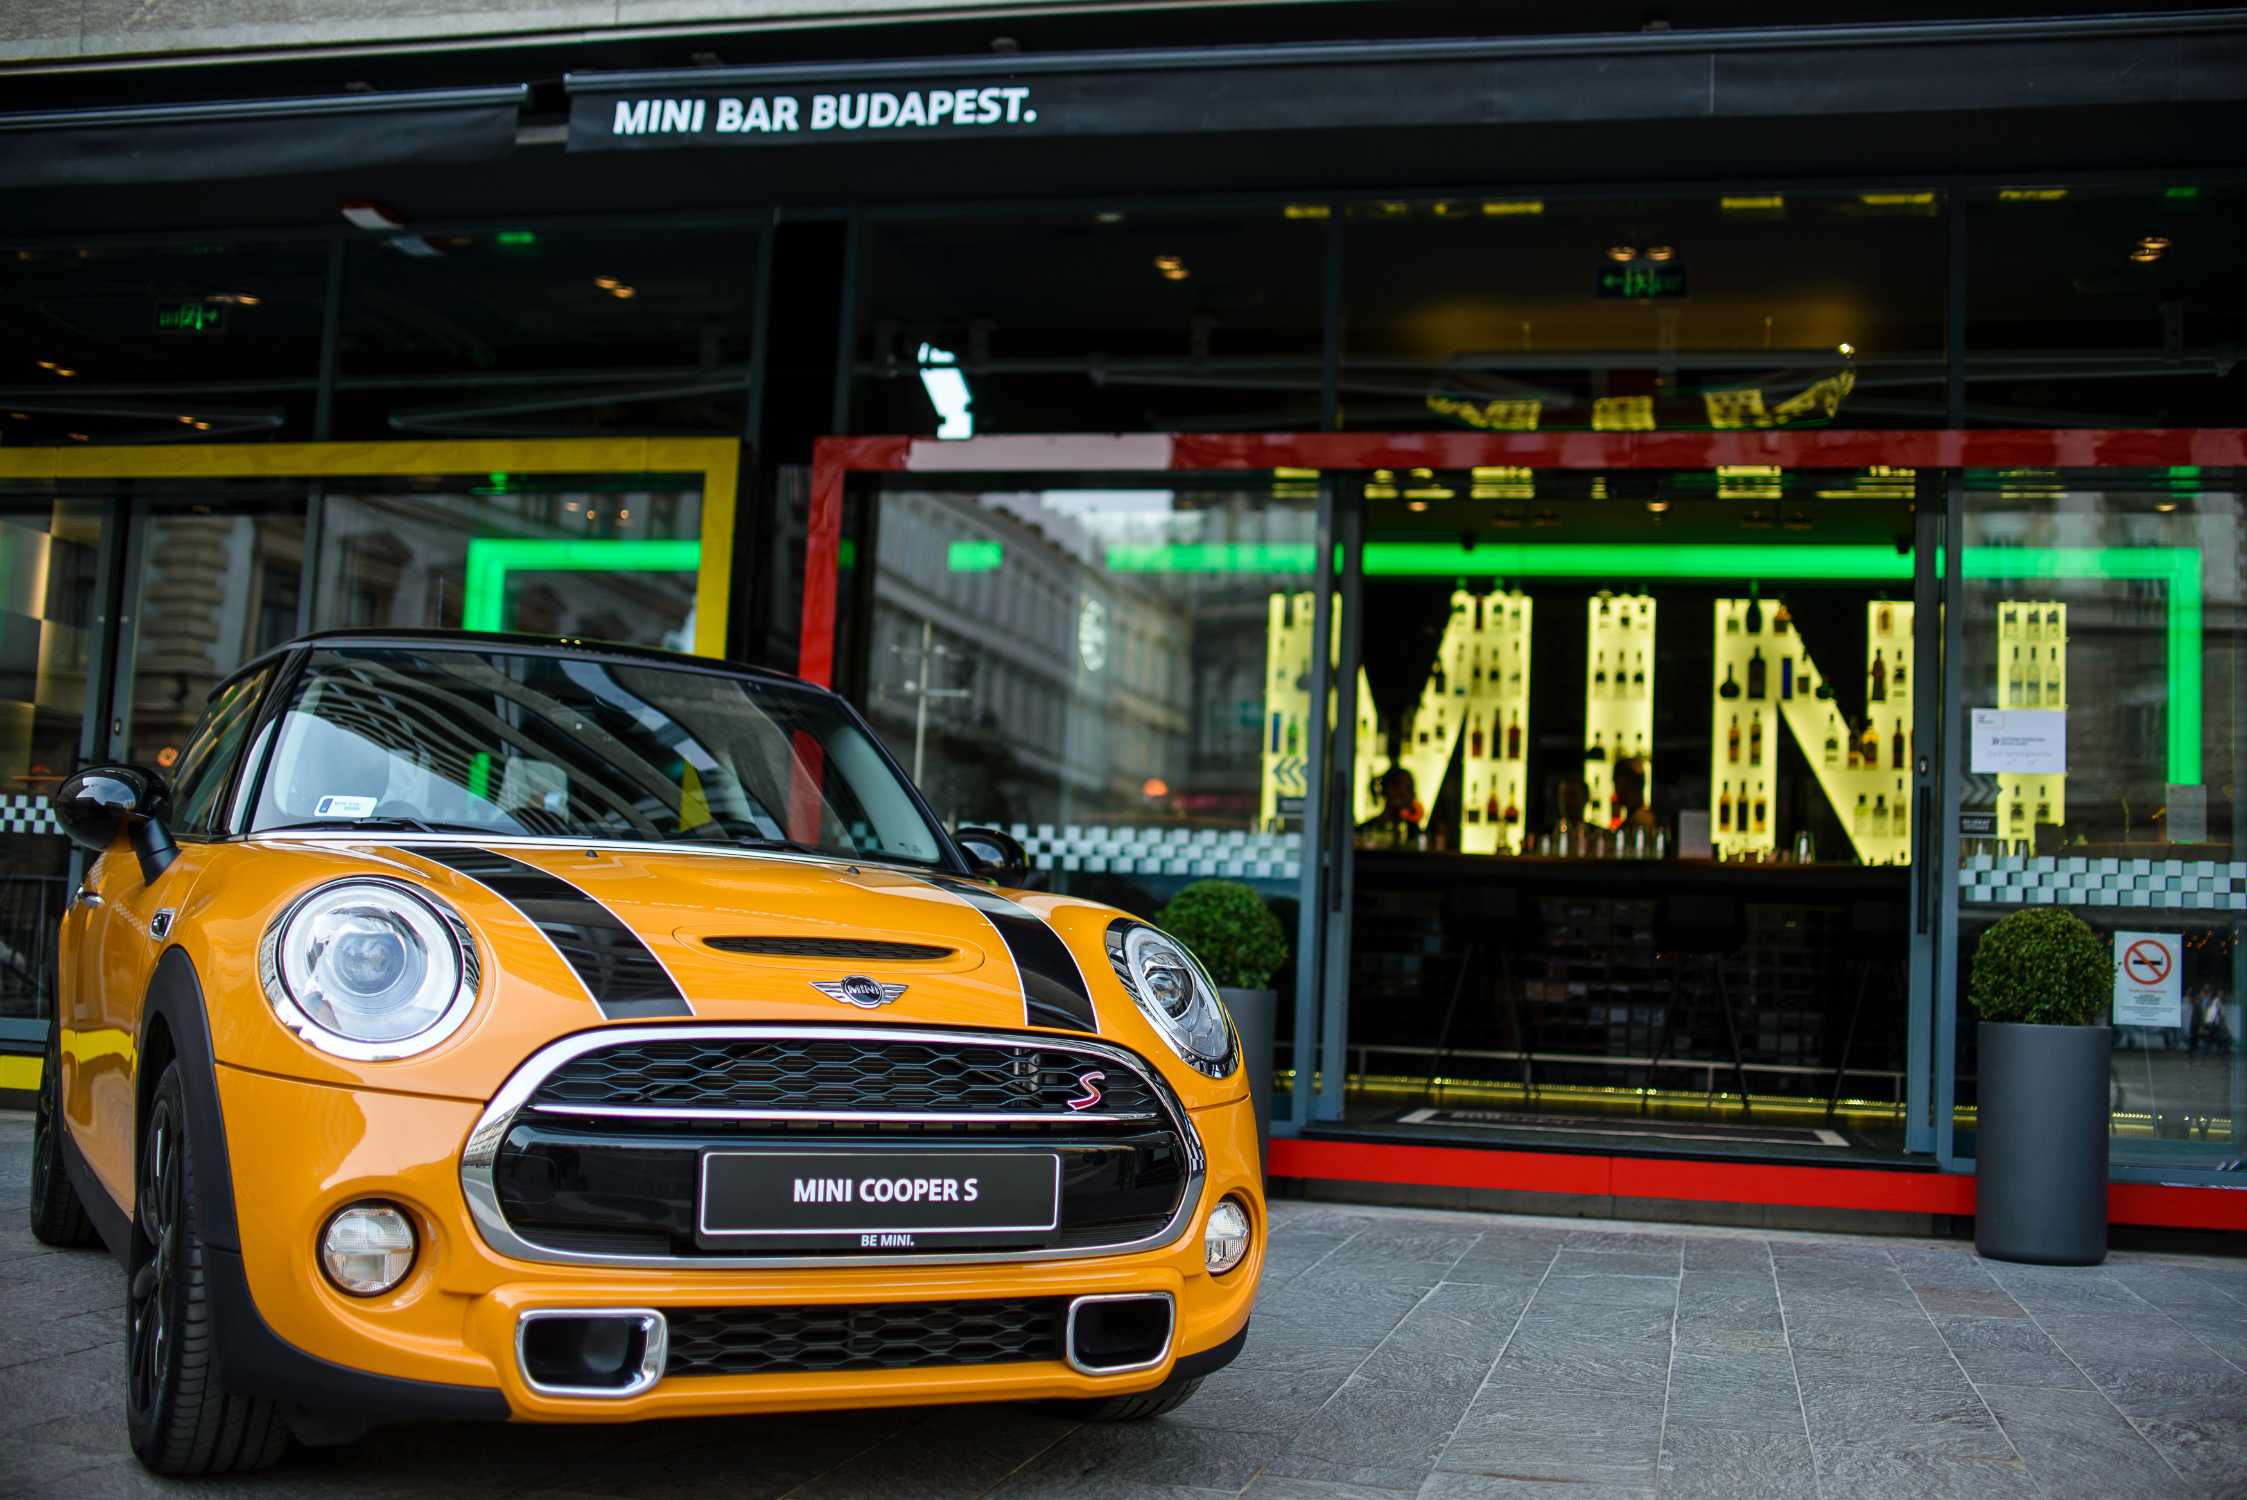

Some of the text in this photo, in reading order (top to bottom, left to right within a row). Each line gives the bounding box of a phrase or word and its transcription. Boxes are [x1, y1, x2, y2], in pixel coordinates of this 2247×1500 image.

[613, 87, 1037, 134] MINI BAR BUDAPEST.
[847, 984, 881, 995] MINI
[1067, 1071, 1105, 1111] S
[793, 1178, 978, 1202] MINI COOPER S
[860, 1233, 915, 1247] BE MINI.
